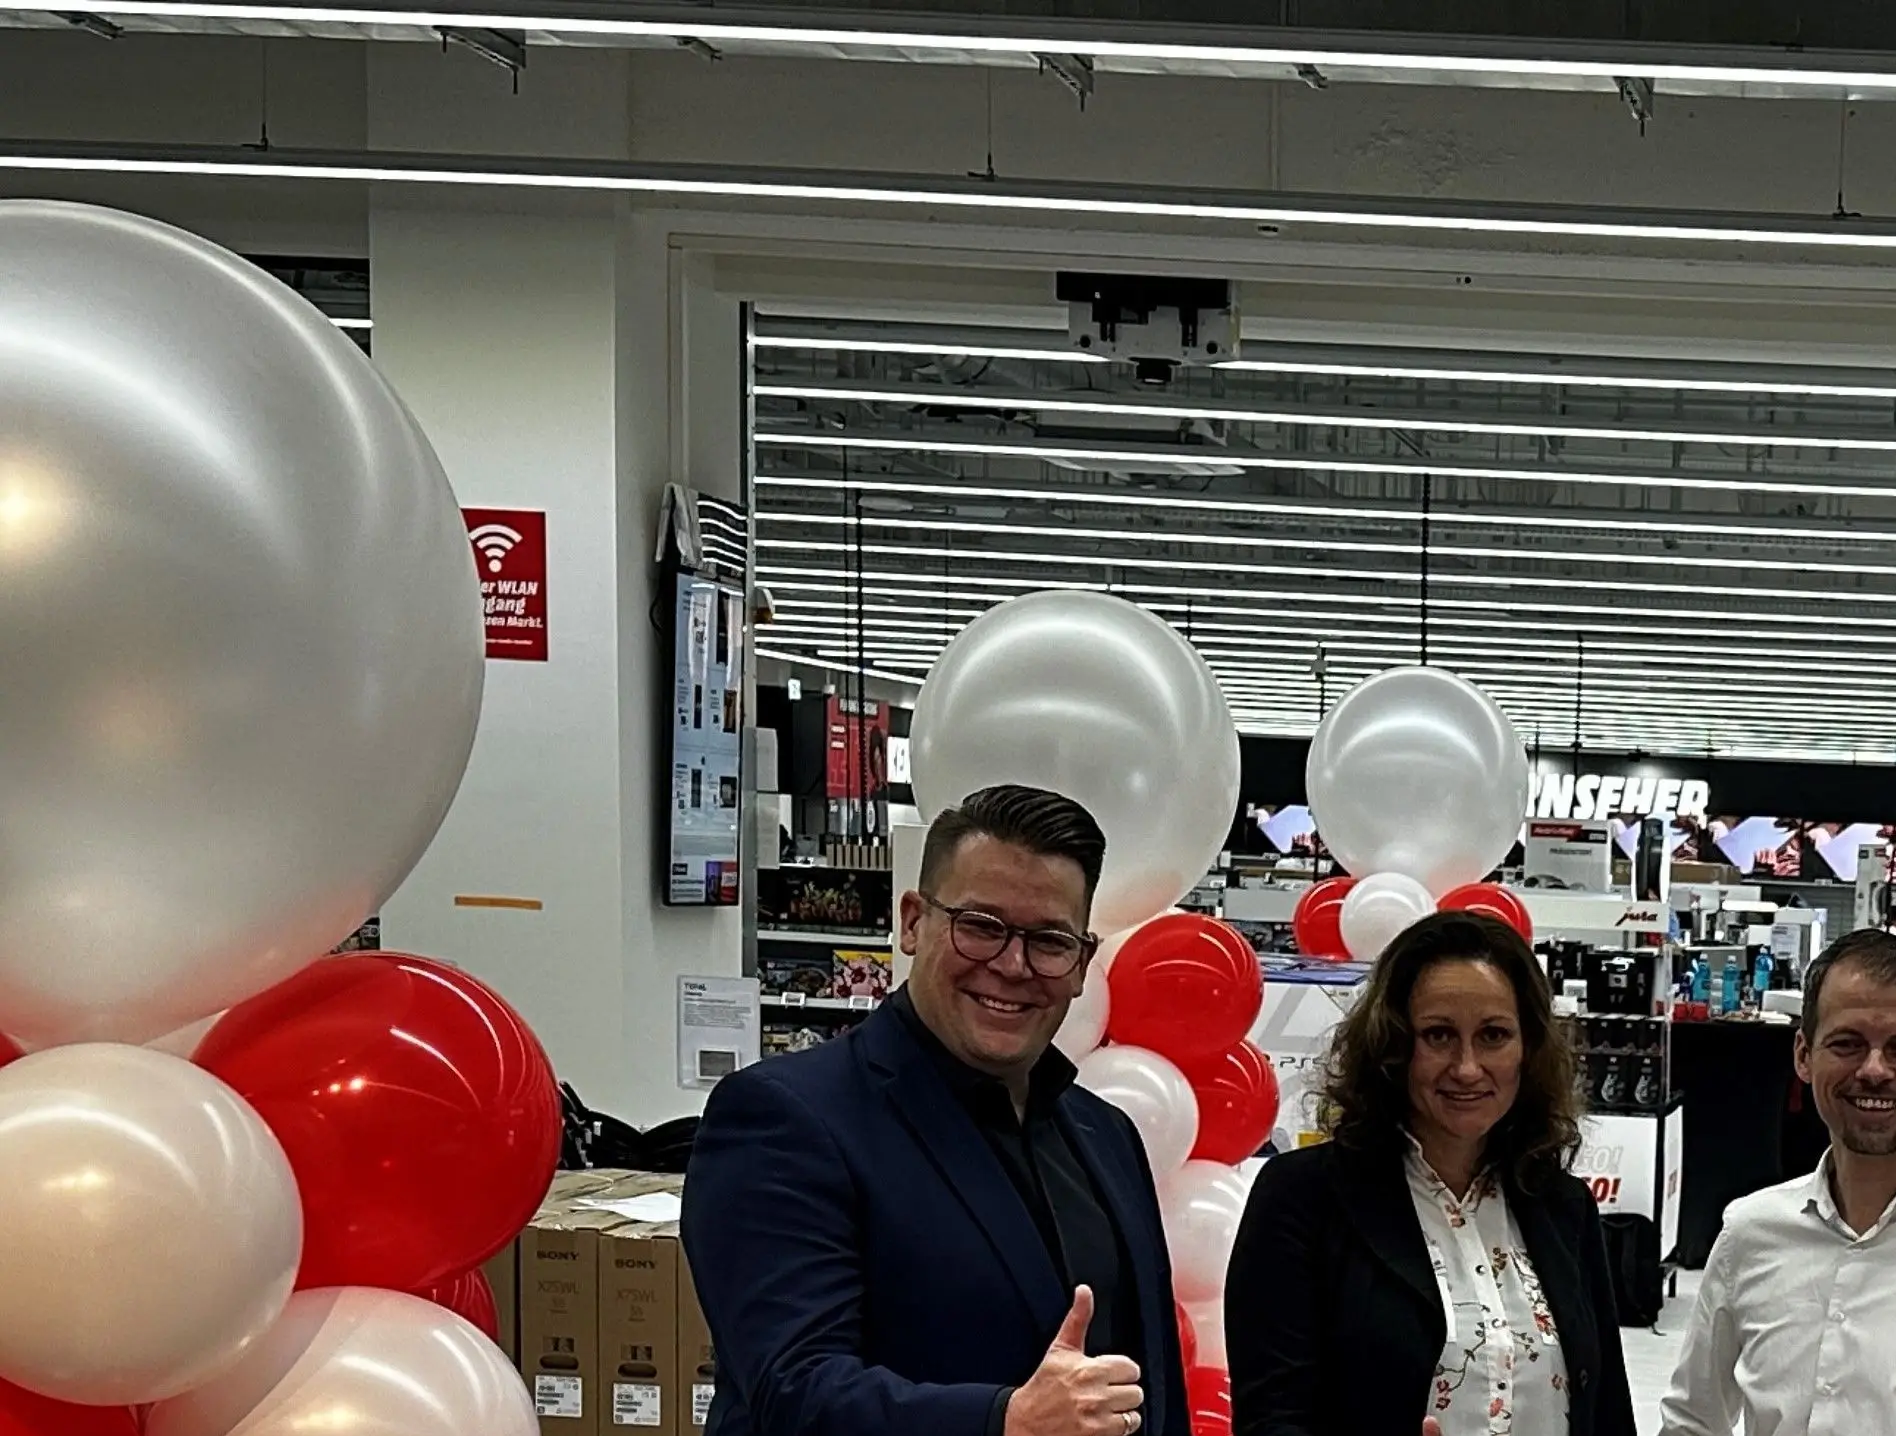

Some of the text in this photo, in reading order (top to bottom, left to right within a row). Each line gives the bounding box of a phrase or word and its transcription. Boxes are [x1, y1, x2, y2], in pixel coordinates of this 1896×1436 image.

[480, 580, 539, 596] er WLAN
[1582, 1176, 1622, 1204] O!
[536, 1250, 579, 1261] SONY
[615, 1258, 656, 1270] SONY
